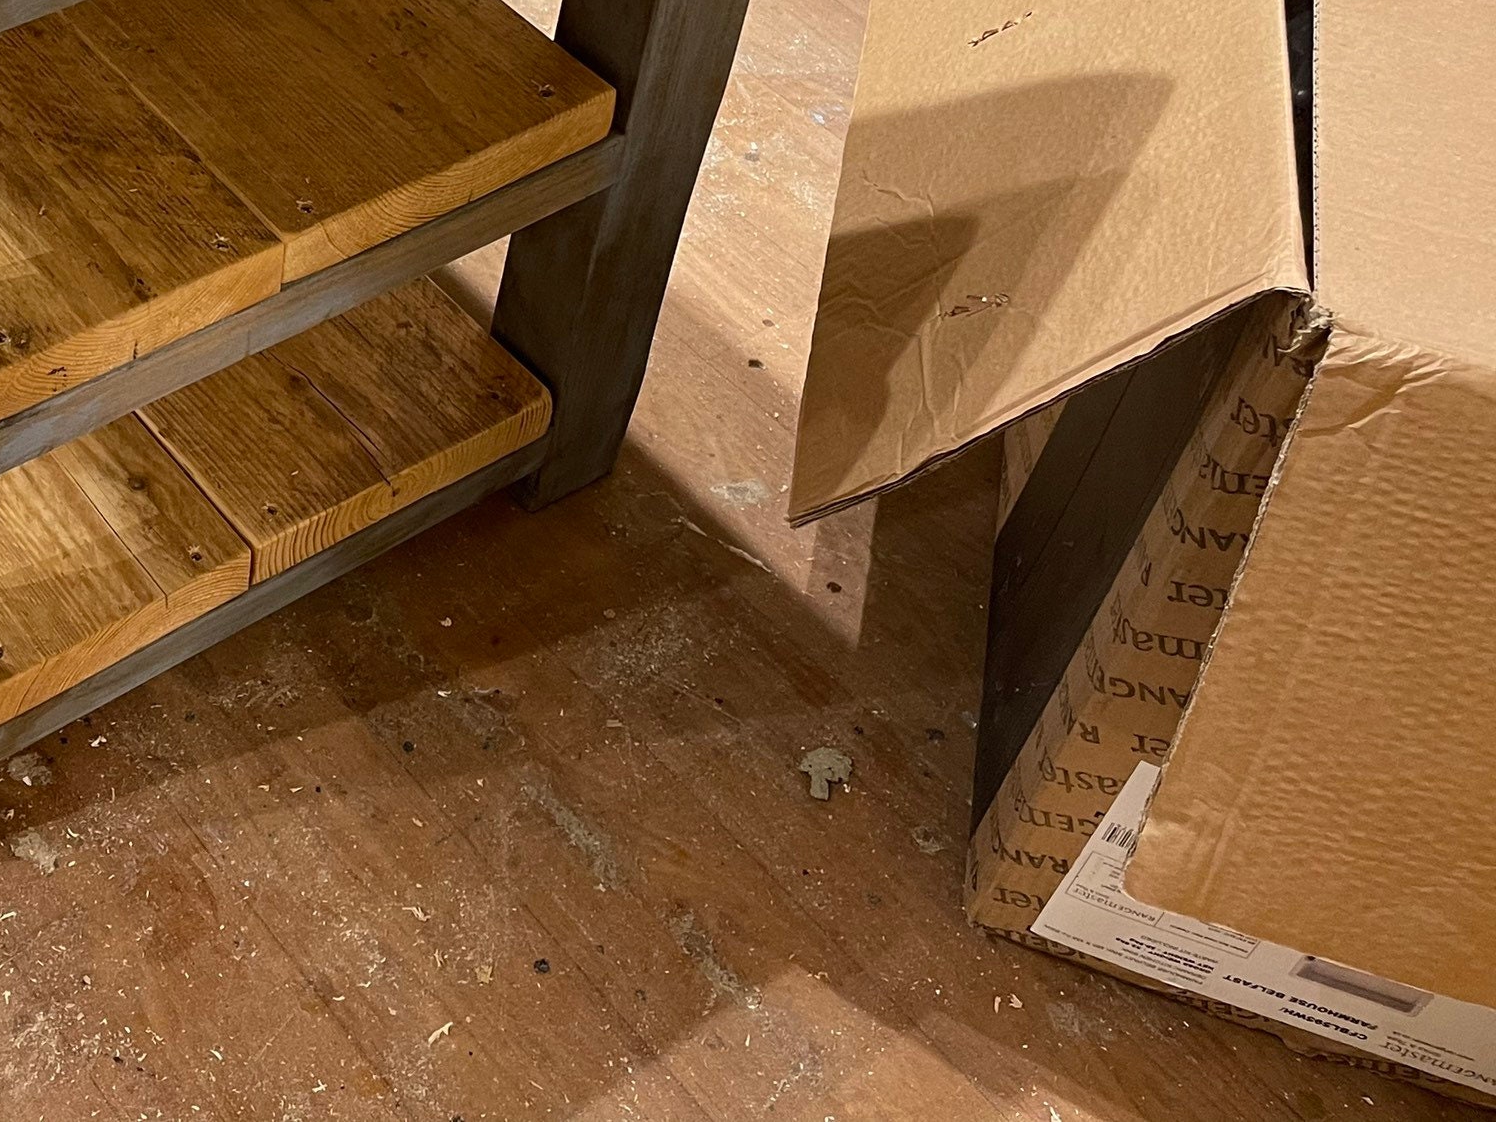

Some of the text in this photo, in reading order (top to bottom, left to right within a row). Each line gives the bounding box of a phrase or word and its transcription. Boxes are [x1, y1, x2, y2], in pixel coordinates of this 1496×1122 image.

[1230, 396, 1295, 449] ter
[1222, 974, 1378, 1031] FARMHOUSE BELFAST
